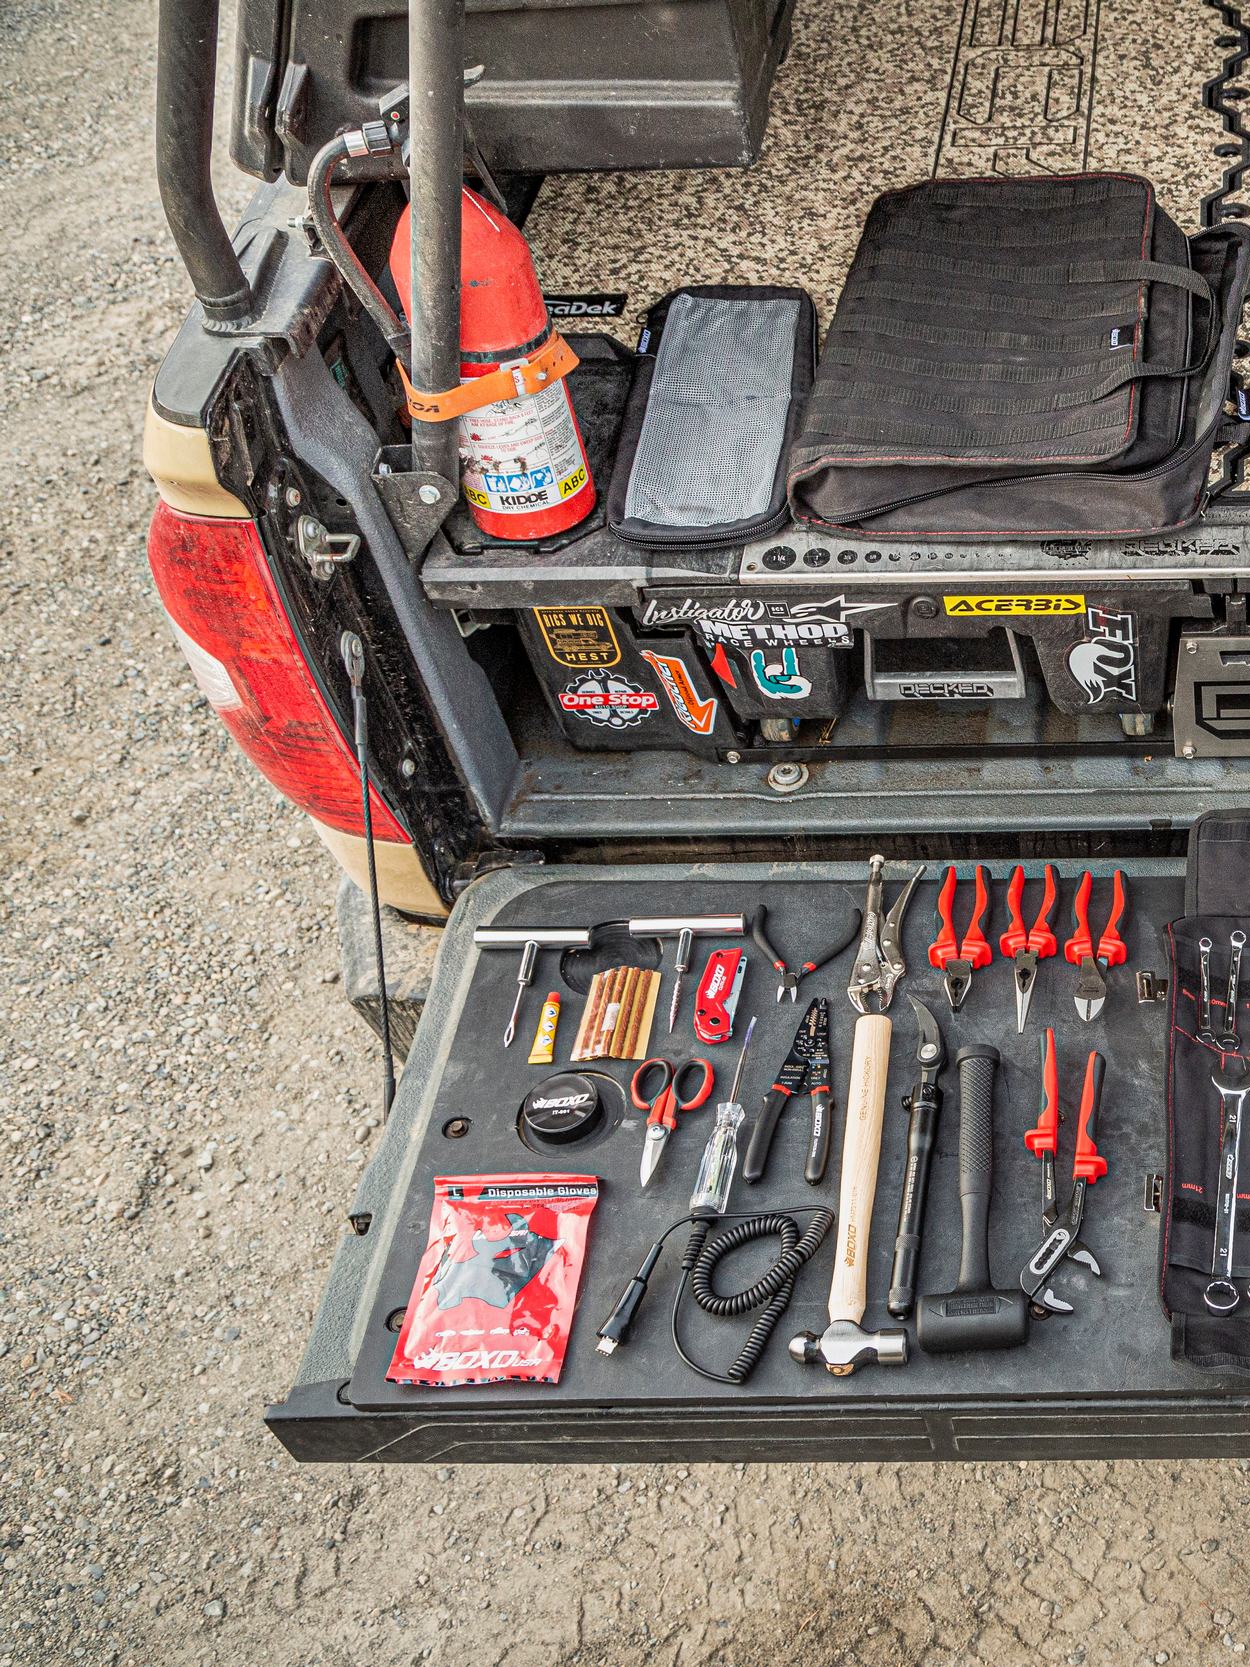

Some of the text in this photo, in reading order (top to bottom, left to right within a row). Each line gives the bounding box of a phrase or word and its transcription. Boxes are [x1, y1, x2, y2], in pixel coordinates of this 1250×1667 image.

[547, 300, 618, 315] eaDek
[563, 468, 586, 494] ABC
[500, 490, 549, 506] KIDDE
[643, 598, 765, 625] Instigator
[950, 599, 1081, 612] ACERBIS
[543, 613, 604, 627] RIGS WE DIG
[699, 619, 849, 641] METHOD
[706, 633, 753, 647] RACE
[767, 635, 850, 646] WHEELS
[565, 652, 609, 661] HEST
[900, 683, 994, 698] DECKED
[563, 694, 654, 707] One Stop
[544, 1093, 590, 1108] BOXO
[1229, 1114, 1237, 1123] 21
[488, 1186, 597, 1199] Disposable Gloves
[1181, 1183, 1204, 1194] 21mm
[1219, 1248, 1228, 1257] 21
[432, 1350, 519, 1371] BOXO
